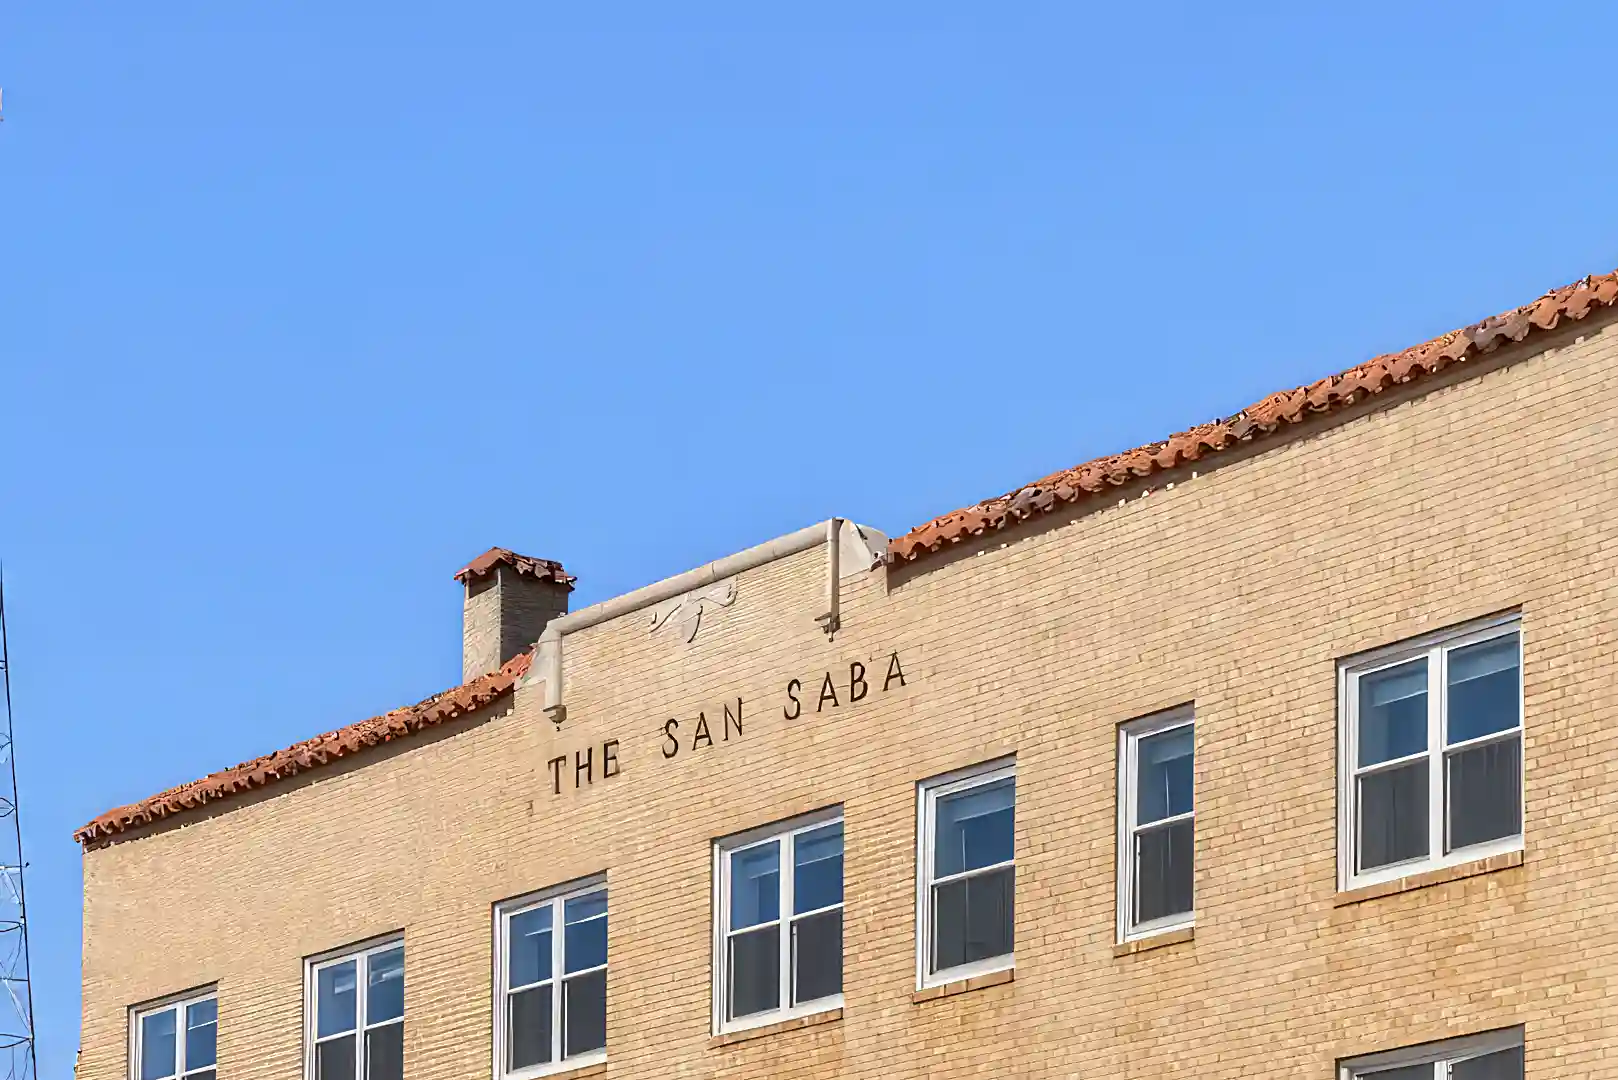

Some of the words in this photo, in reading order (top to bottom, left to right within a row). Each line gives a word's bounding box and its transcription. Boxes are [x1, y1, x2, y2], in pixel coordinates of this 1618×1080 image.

[547, 739, 621, 795] THE
[661, 697, 744, 760] SAN
[783, 651, 907, 721] SABA
